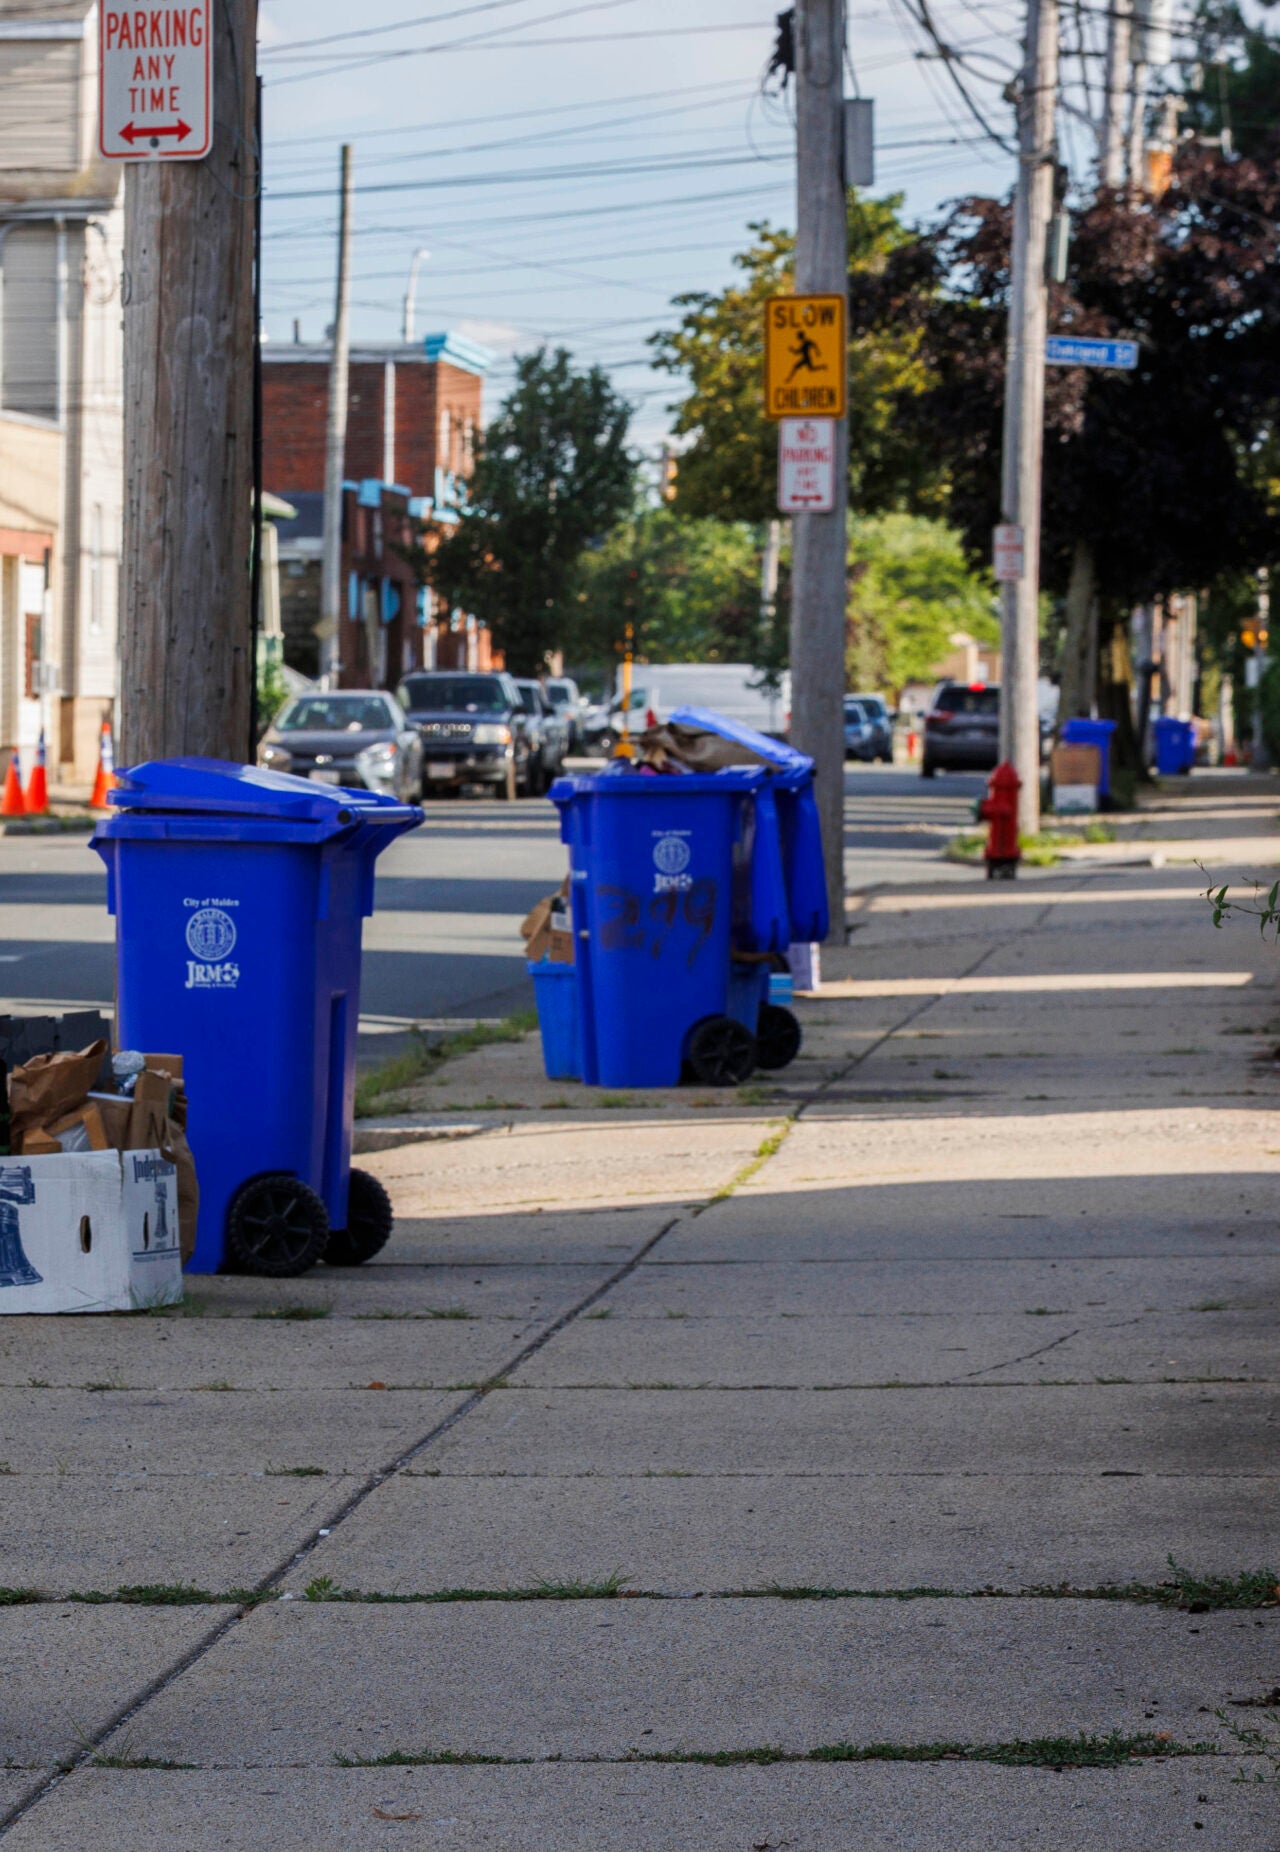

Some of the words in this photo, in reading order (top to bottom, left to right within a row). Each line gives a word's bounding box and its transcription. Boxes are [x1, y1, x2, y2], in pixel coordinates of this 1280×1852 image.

[106, 7, 203, 51] PARKING
[132, 53, 176, 82] ANY
[128, 85, 181, 113] TIME
[773, 305, 836, 329] SLOW
[774, 386, 837, 411] CHILDREN
[796, 426, 818, 443] NO
[783, 447, 833, 464] PARKING
[183, 897, 200, 908] City
[201, 898, 210, 907] of
[184, 960, 222, 989] JRM
